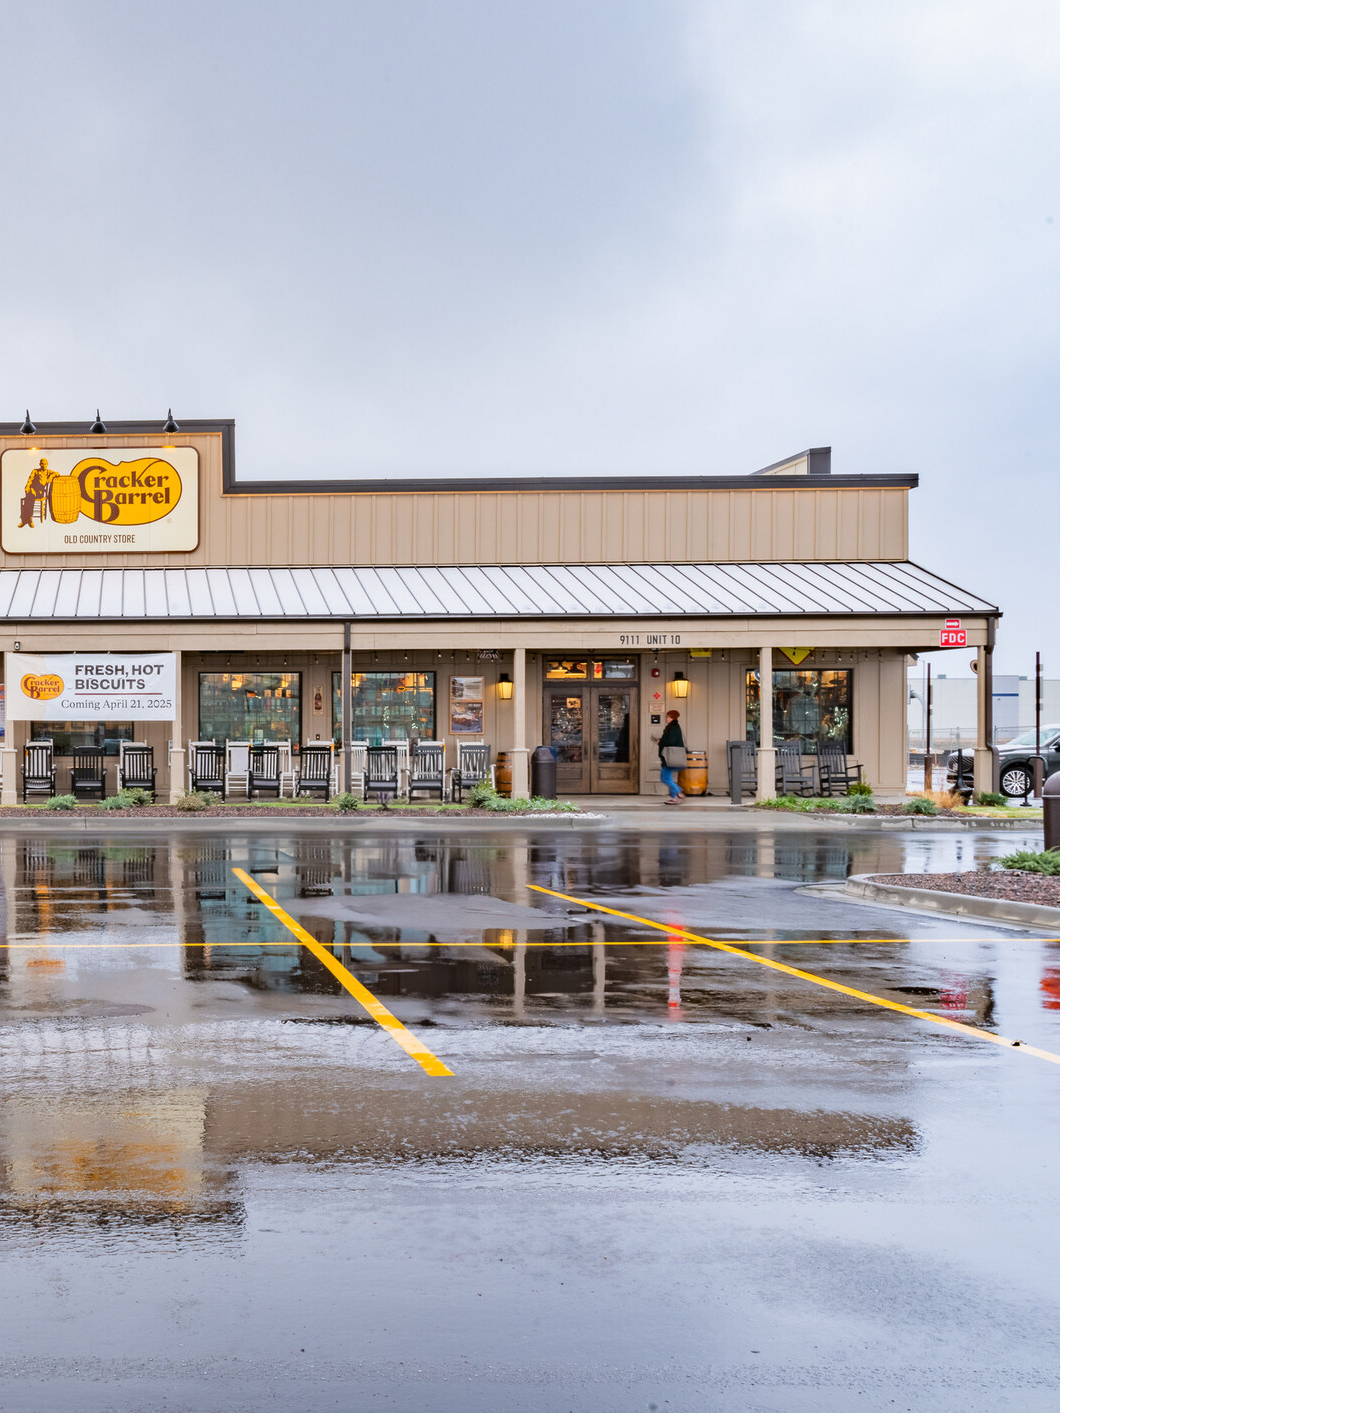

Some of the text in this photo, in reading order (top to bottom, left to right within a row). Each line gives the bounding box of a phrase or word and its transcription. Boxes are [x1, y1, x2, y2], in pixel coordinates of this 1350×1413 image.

[77, 465, 169, 504] Cracker
[94, 487, 171, 523] Barrel
[64, 534, 136, 544] OLD COUNTRY STORE
[620, 635, 681, 645] 9111 UNIT 10
[941, 632, 965, 644] FDC
[75, 664, 164, 677] FRESH, HOT
[23, 676, 60, 692] Cracker
[75, 679, 146, 690] BISCUITS
[30, 685, 60, 700] Barrel
[61, 699, 101, 710] Coming
[102, 699, 128, 710] April
[147, 699, 172, 709] 2025
